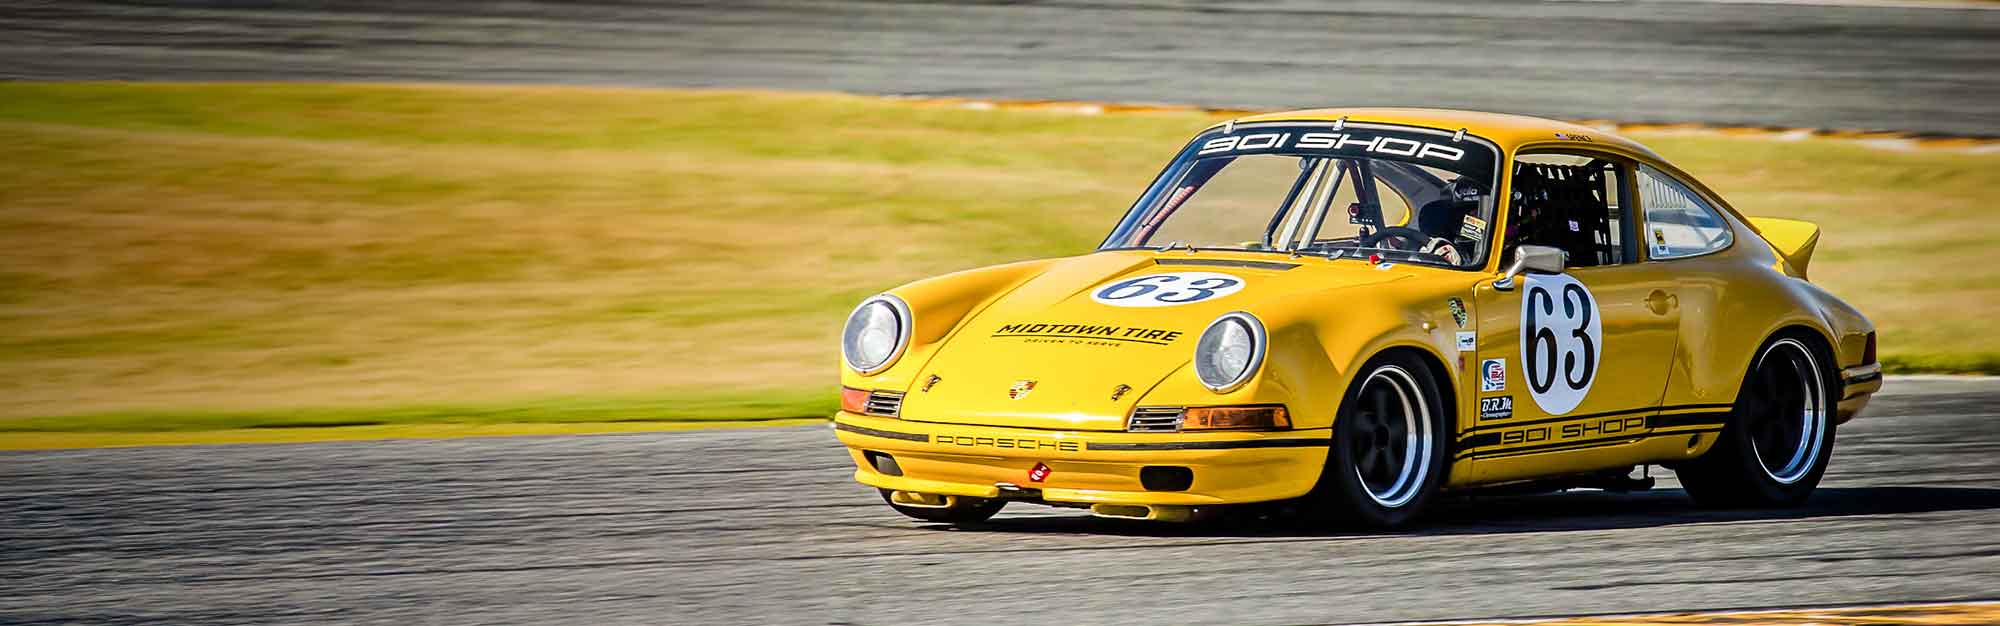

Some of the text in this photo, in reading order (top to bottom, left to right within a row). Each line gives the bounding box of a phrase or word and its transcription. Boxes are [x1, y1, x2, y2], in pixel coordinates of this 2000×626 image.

[1199, 132, 1465, 162] 901 SHOP
[1096, 275, 1240, 303] 63
[996, 323, 1184, 343] MIDTOWN TIRE
[1525, 282, 1595, 395] 63
[936, 435, 1079, 452] PORSCHE
[1503, 416, 1645, 445] 901 SHOP
